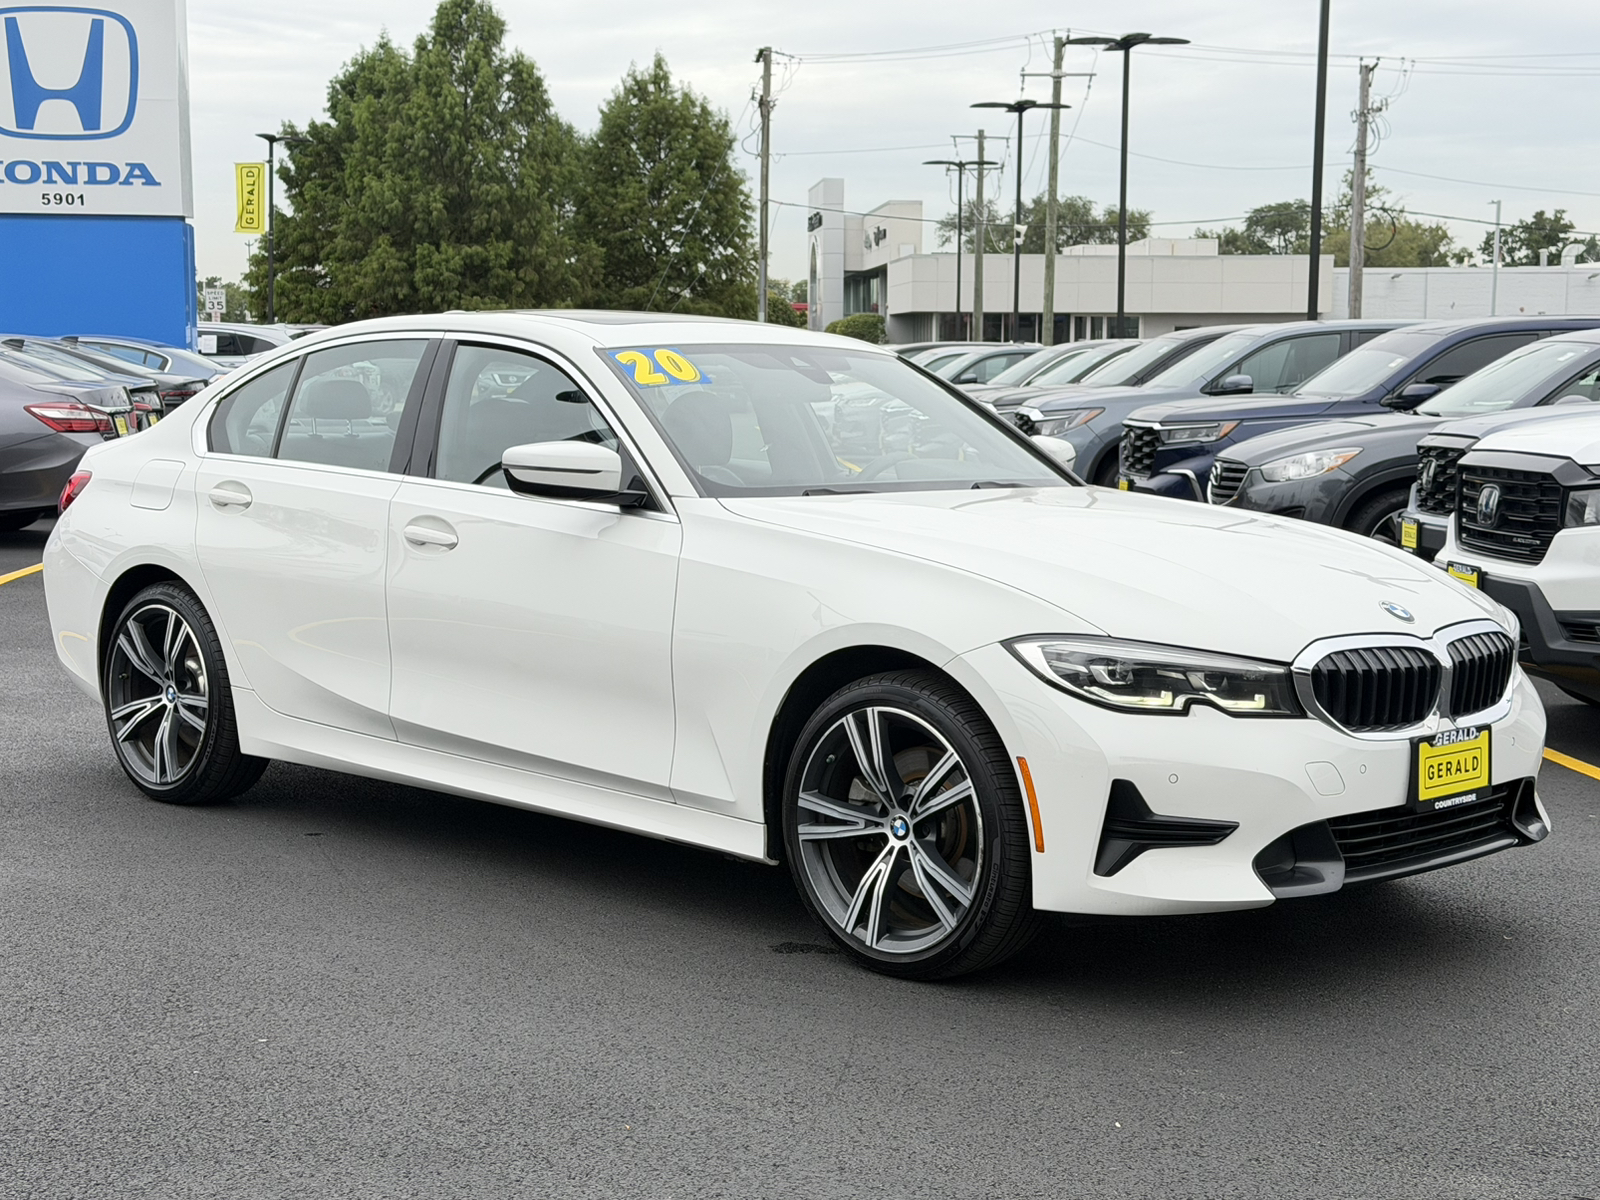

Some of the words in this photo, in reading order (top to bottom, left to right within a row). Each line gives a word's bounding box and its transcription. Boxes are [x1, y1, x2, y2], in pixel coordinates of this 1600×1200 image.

[0, 160, 162, 186] ONDA
[41, 192, 85, 206] 5901
[245, 170, 256, 225] GERALD
[208, 300, 224, 311] 35
[614, 347, 701, 386] 20
[1435, 727, 1477, 746] GERALD
[1427, 755, 1479, 781] GERALD
[1434, 792, 1477, 810] COUNTRYSIDE
